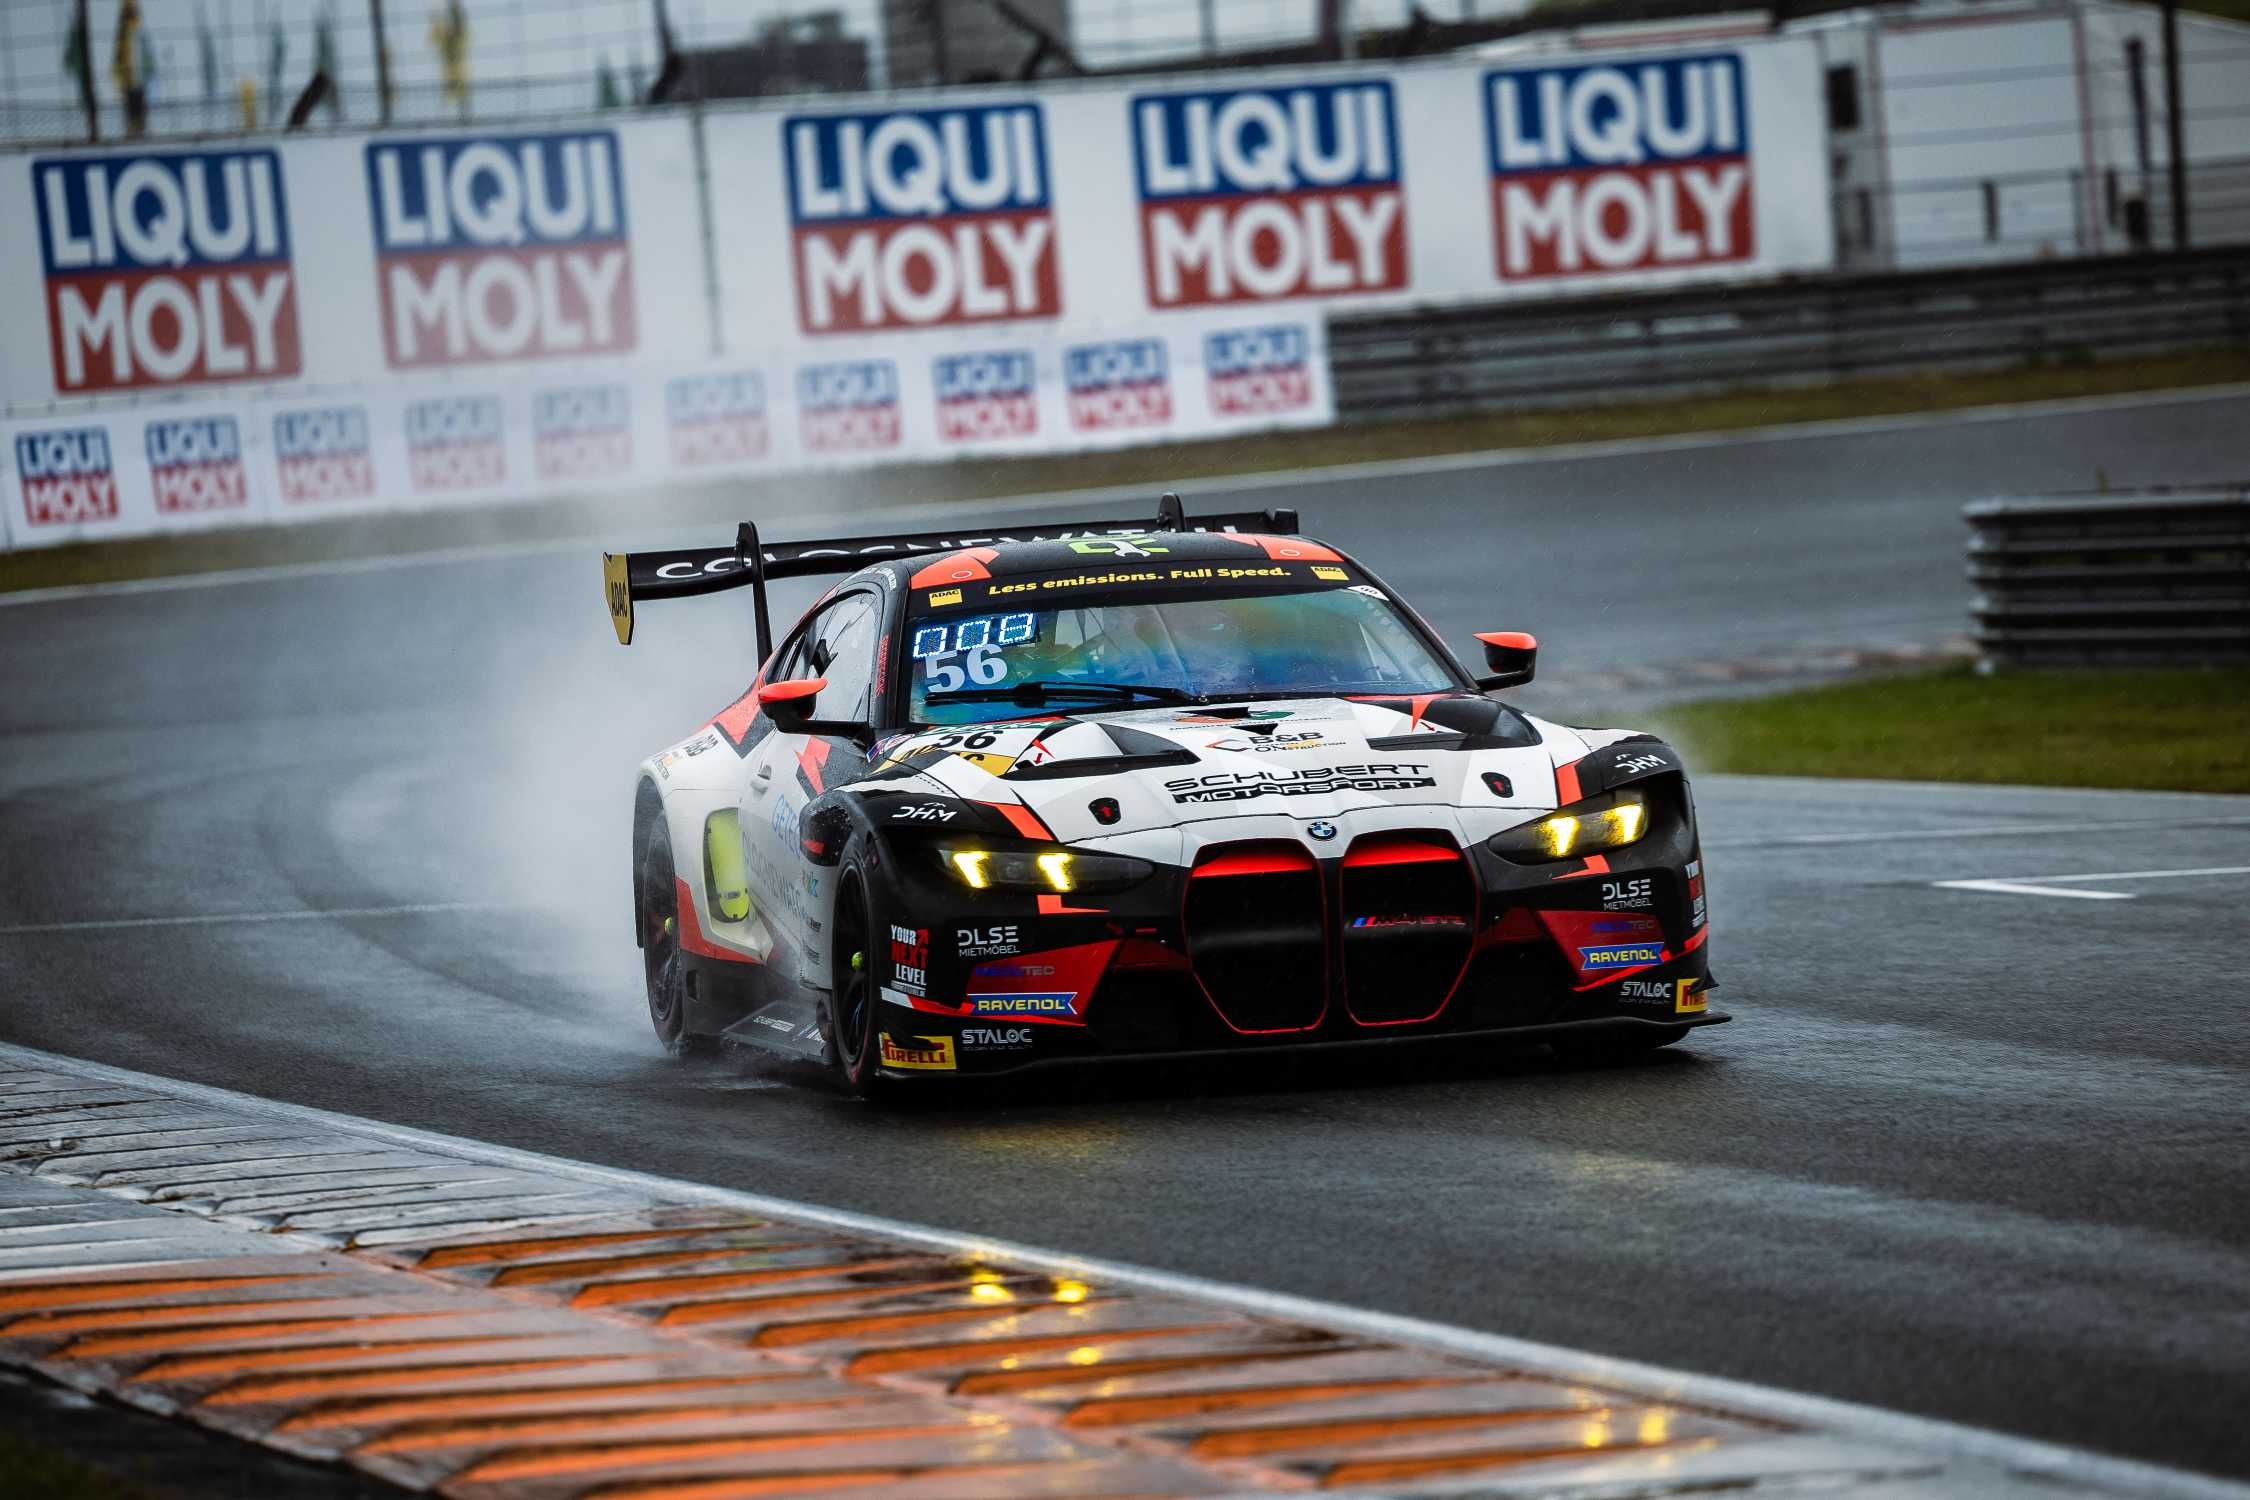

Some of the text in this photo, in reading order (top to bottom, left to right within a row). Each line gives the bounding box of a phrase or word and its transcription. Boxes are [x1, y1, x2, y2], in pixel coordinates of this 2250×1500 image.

[1493, 63, 1740, 171] LIQUI
[797, 109, 1042, 213] LIQUI
[1138, 88, 1391, 191] LIQUI
[43, 156, 279, 268] LIQUI
[377, 138, 615, 246] LIQUI
[1503, 165, 1747, 275] MOLY
[1149, 192, 1403, 300] MOLY
[804, 218, 1051, 329] MOLY
[388, 243, 626, 361] MOLY
[57, 271, 289, 388] MOLY
[21, 431, 109, 475] LIQUI
[150, 418, 237, 463] LIQUI
[27, 476, 117, 519] MOLY
[158, 462, 246, 508] MOLY
[930, 588, 961, 600] ADAC
[989, 566, 1292, 596] Less emissions. Full Speed.
[925, 643, 1008, 694] 56
[1164, 763, 1430, 792] SCHUBERT
[1184, 778, 1426, 803] MOTORSPORT
[1602, 878, 1652, 900] DLSE
[890, 924, 917, 945] YOUR
[890, 942, 929, 970] NEXT
[957, 925, 1019, 947] DLSE
[895, 962, 927, 987] LEVEL
[1589, 949, 1657, 964] RAVENOL
[977, 998, 1067, 1012] RAVENOL
[1619, 981, 1673, 999] STALOC
[961, 1028, 1033, 1045] STALOC
